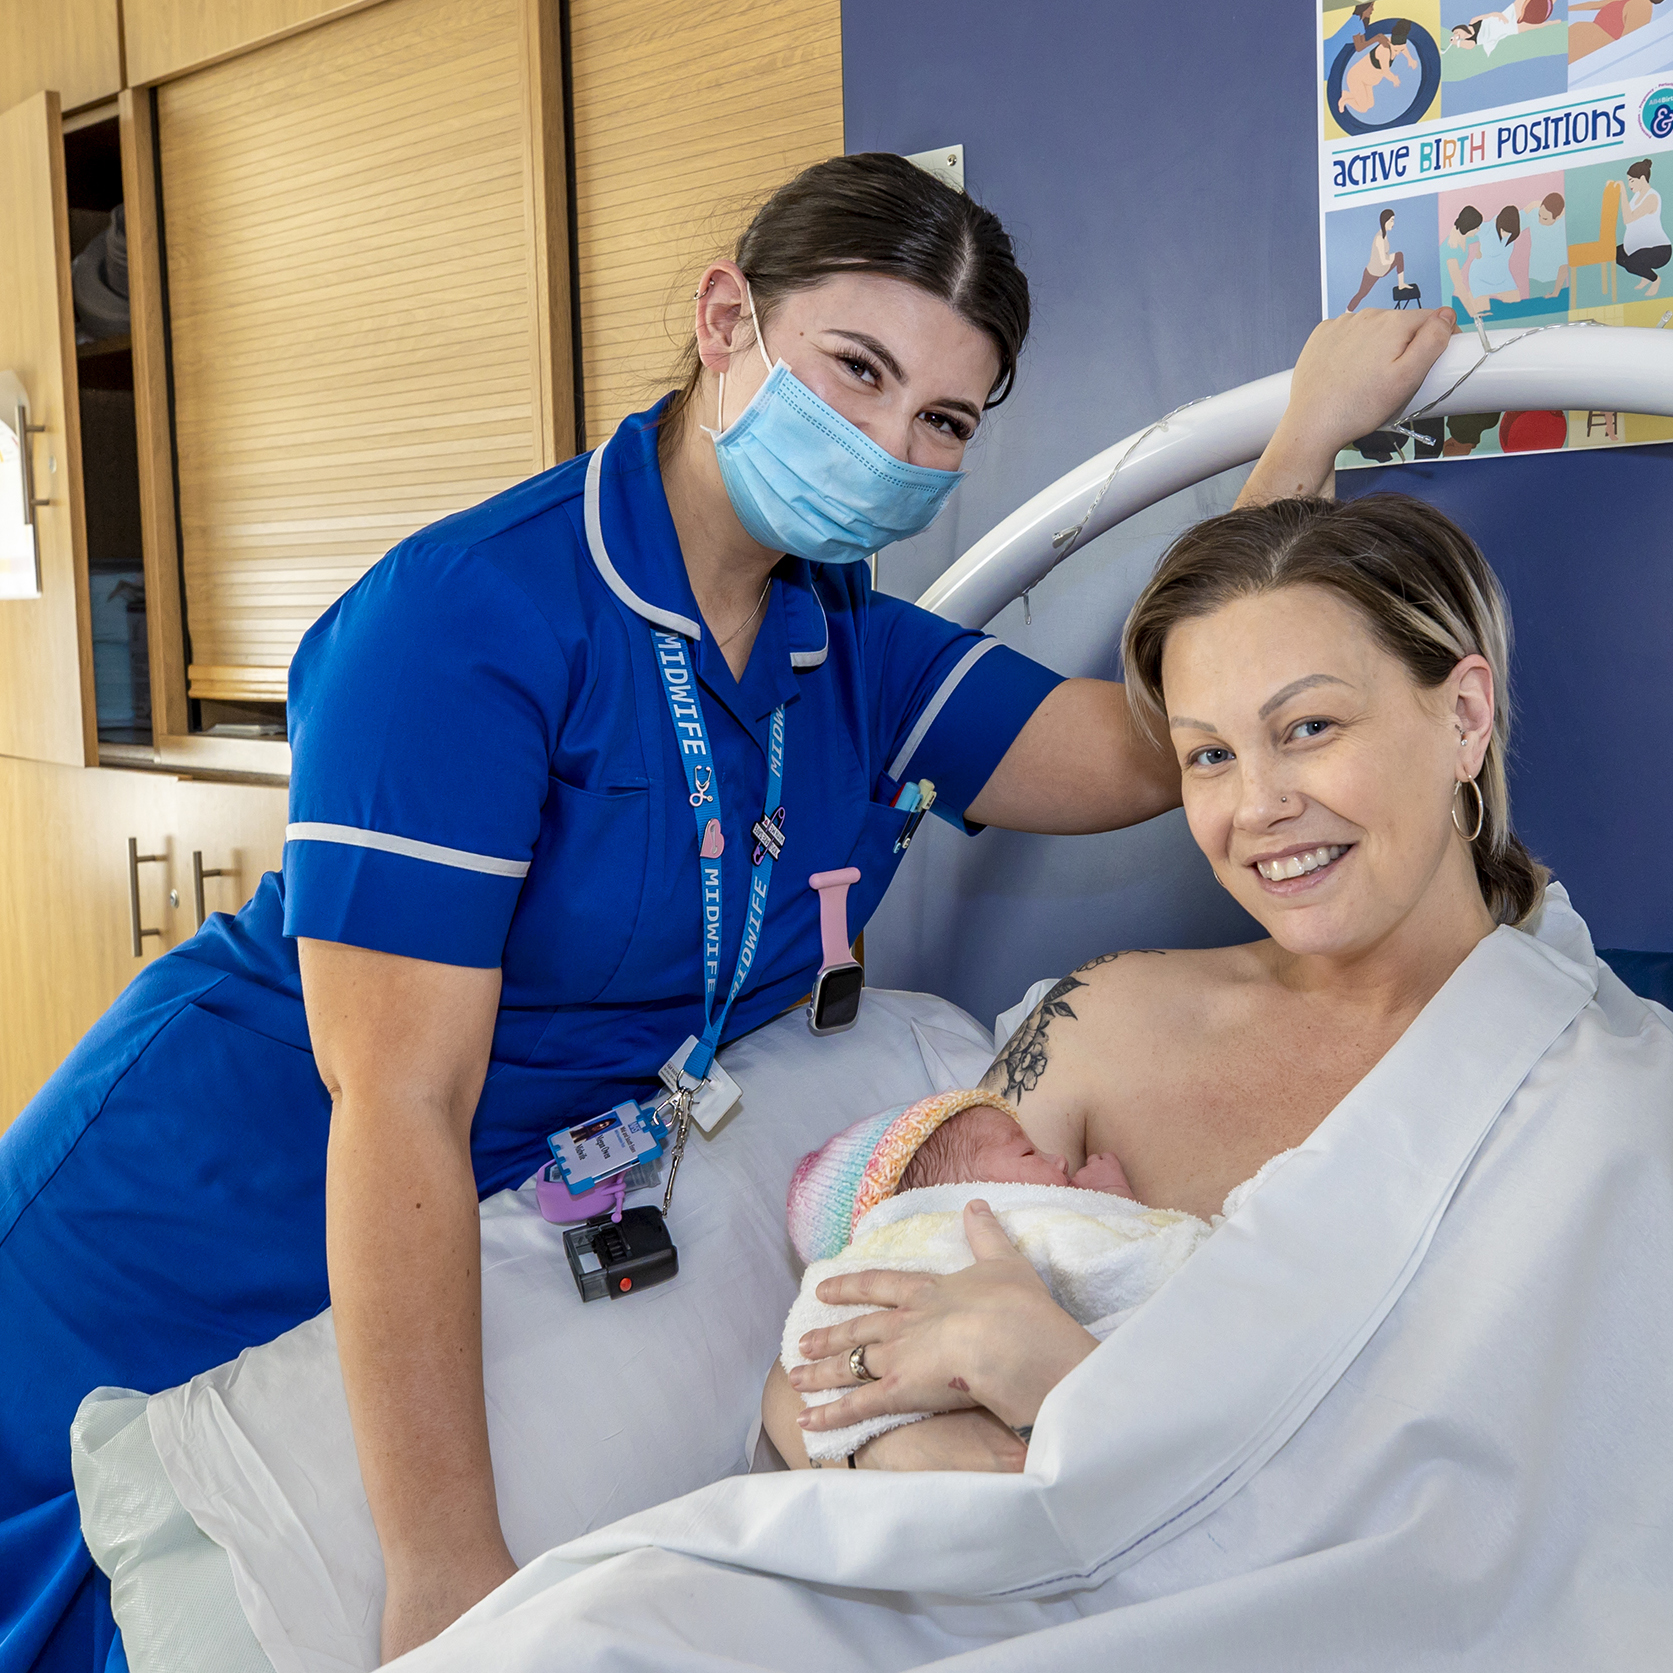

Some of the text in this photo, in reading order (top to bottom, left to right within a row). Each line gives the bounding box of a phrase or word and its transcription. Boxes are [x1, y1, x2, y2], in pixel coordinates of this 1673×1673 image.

[1420, 131, 1485, 173] BIRTH
[655, 632, 707, 755] MIDWIFE
[770, 704, 784, 778] MIDW
[705, 868, 720, 993] MIDWIFE
[731, 876, 767, 1001] MIDWIFE
[575, 1143, 587, 1161] Midwife
